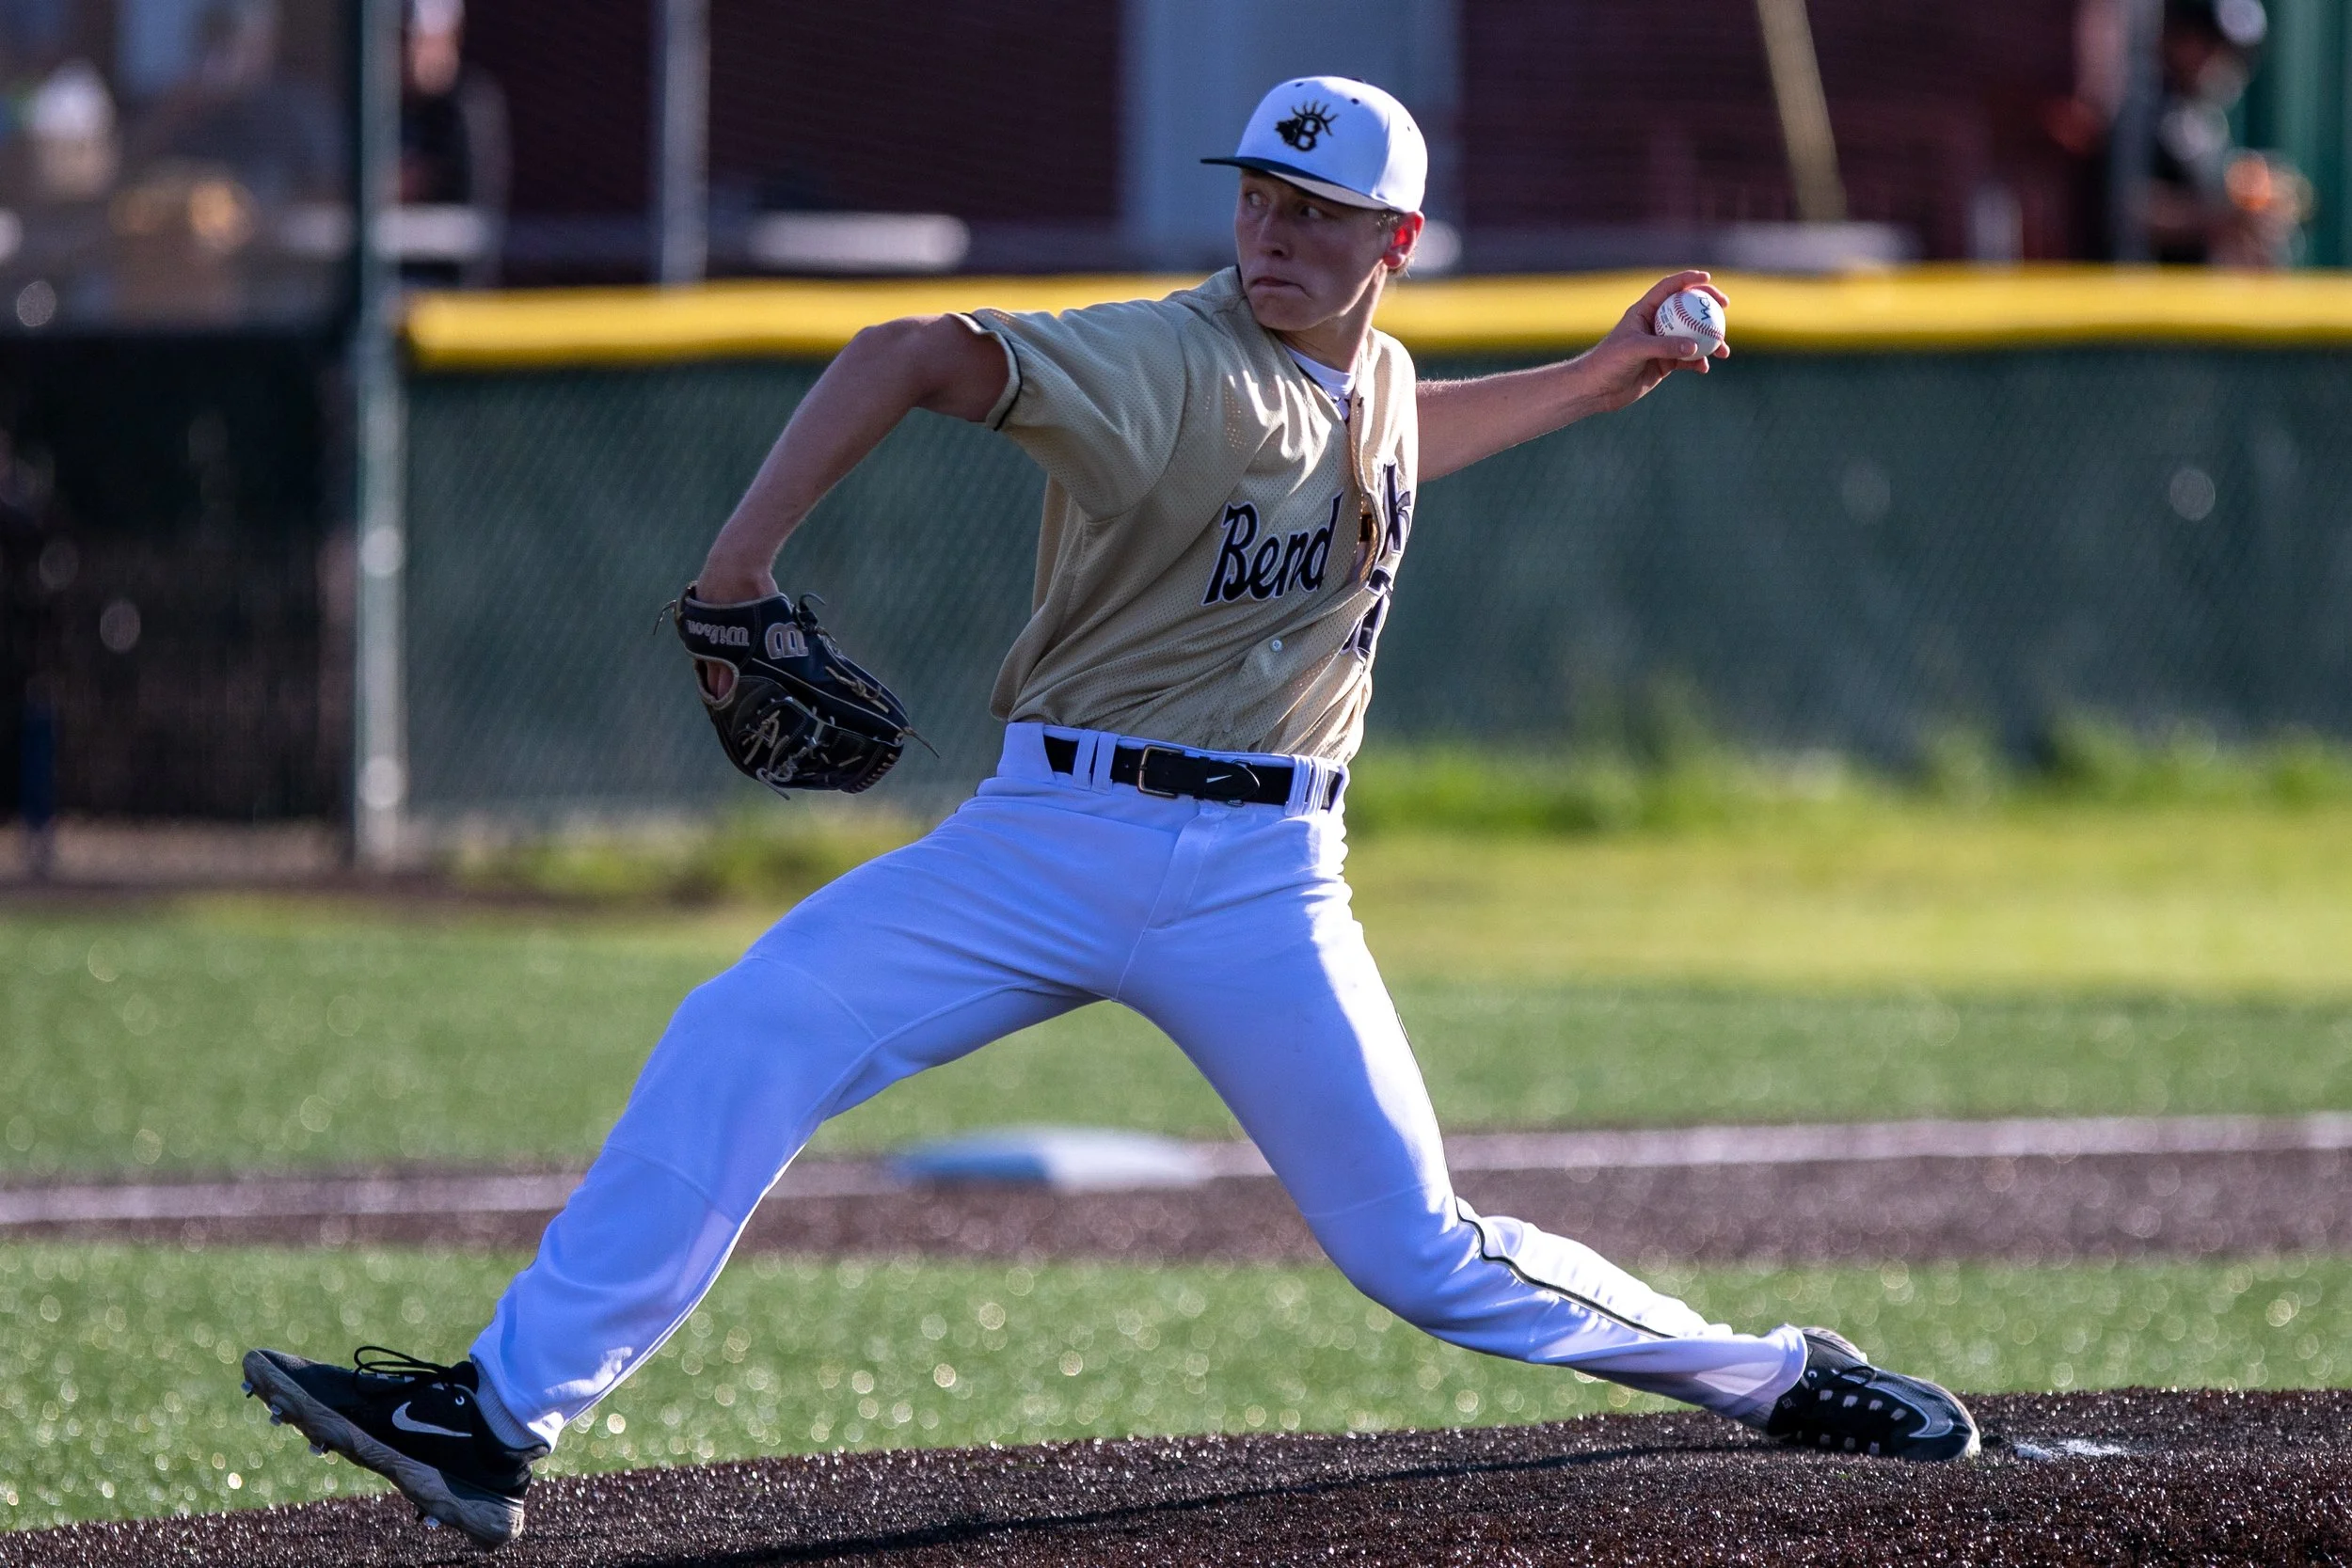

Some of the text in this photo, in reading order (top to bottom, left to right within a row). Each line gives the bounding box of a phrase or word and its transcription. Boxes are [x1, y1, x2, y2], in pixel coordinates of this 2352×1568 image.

[1294, 117, 1322, 151] B
[1202, 491, 1343, 607] Bend
[686, 619, 750, 646] Wilson
[765, 622, 808, 660] W
